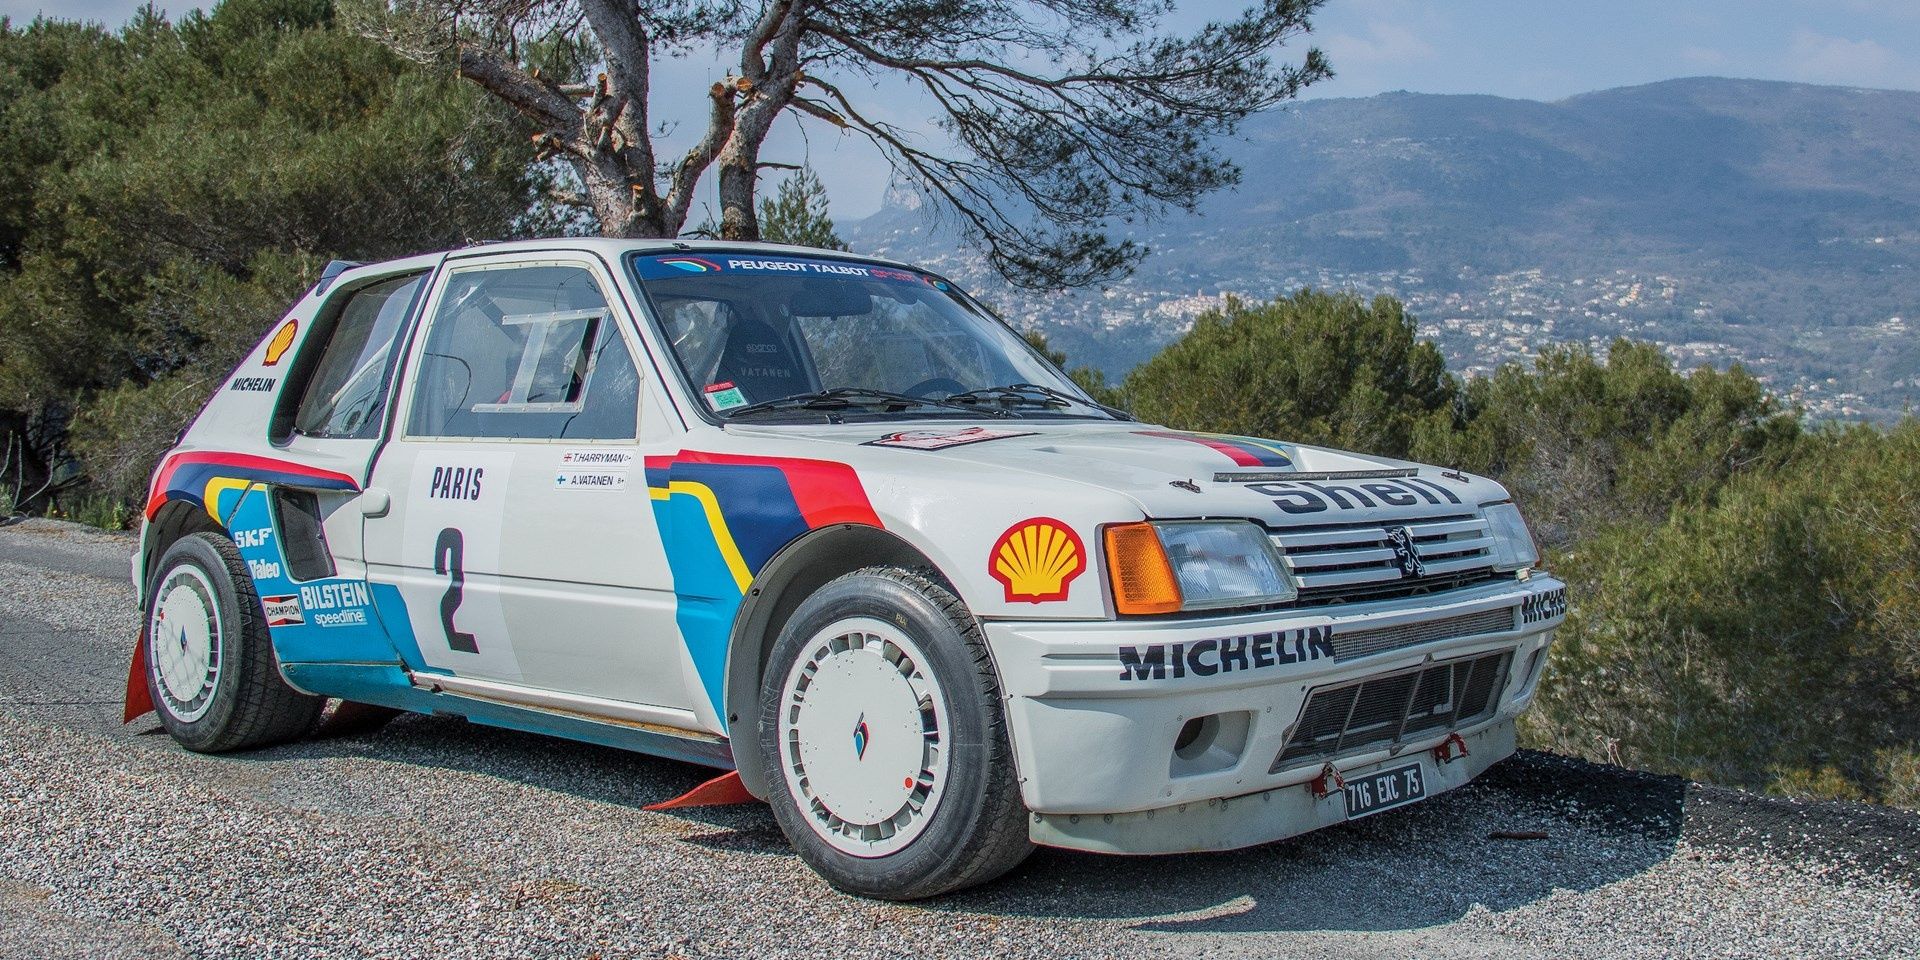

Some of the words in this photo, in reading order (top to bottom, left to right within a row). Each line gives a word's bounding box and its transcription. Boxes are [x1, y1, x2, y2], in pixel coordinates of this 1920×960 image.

[728, 259, 807, 272] PEUGEOT
[810, 263, 869, 277] TALBOT
[231, 377, 276, 393] MICHELIN
[573, 453, 624, 463] T.HARRYMAN
[430, 466, 484, 501] PARIS
[571, 475, 614, 486] A.VATANEN
[1244, 478, 1462, 514] Shell
[235, 528, 273, 549] SKF
[248, 558, 280, 580] Valeo
[301, 582, 370, 610] BILSTEIN
[434, 527, 480, 655] 2
[266, 604, 300, 616] CHAMPION
[1521, 587, 1566, 624] MICHE
[314, 608, 363, 627] speedline
[1119, 625, 1336, 681] MICHELIN
[1348, 782, 1371, 811] 716
[1376, 774, 1399, 804] EXC
[1403, 768, 1420, 796] 75
